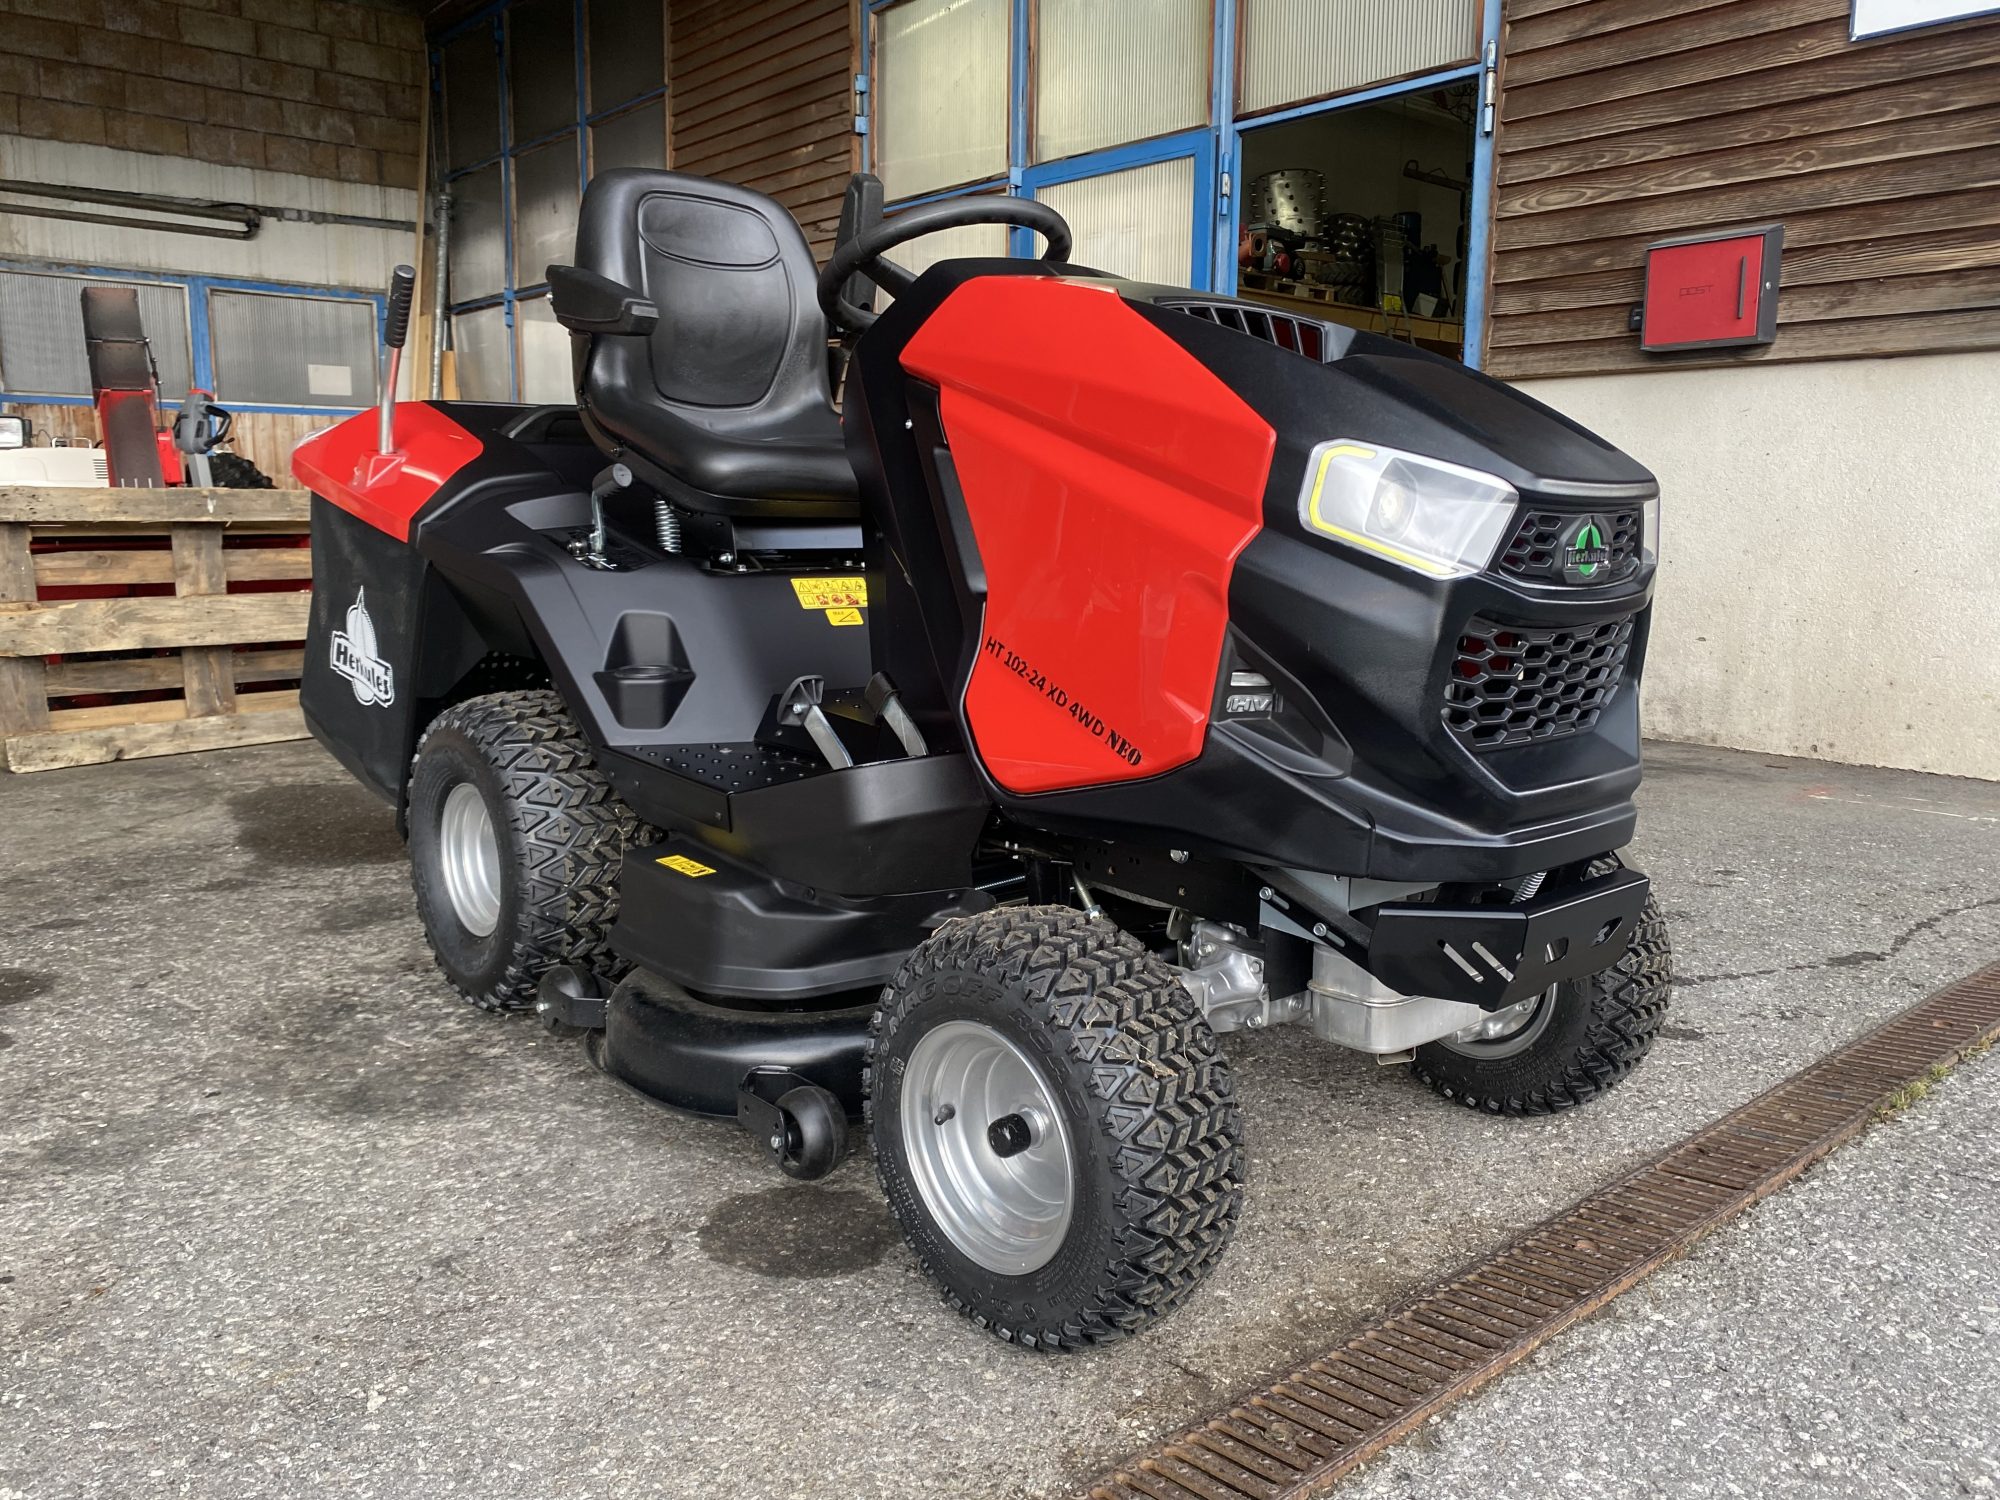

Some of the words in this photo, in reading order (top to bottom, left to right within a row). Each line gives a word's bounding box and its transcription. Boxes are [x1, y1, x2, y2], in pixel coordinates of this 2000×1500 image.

[985, 636, 1005, 658] HT
[1003, 651, 1047, 692] 102-24
[1046, 682, 1068, 707] XD
[1069, 702, 1105, 737] 4WD
[1104, 729, 1142, 766] NEO
[1227, 697, 1272, 712] HV
